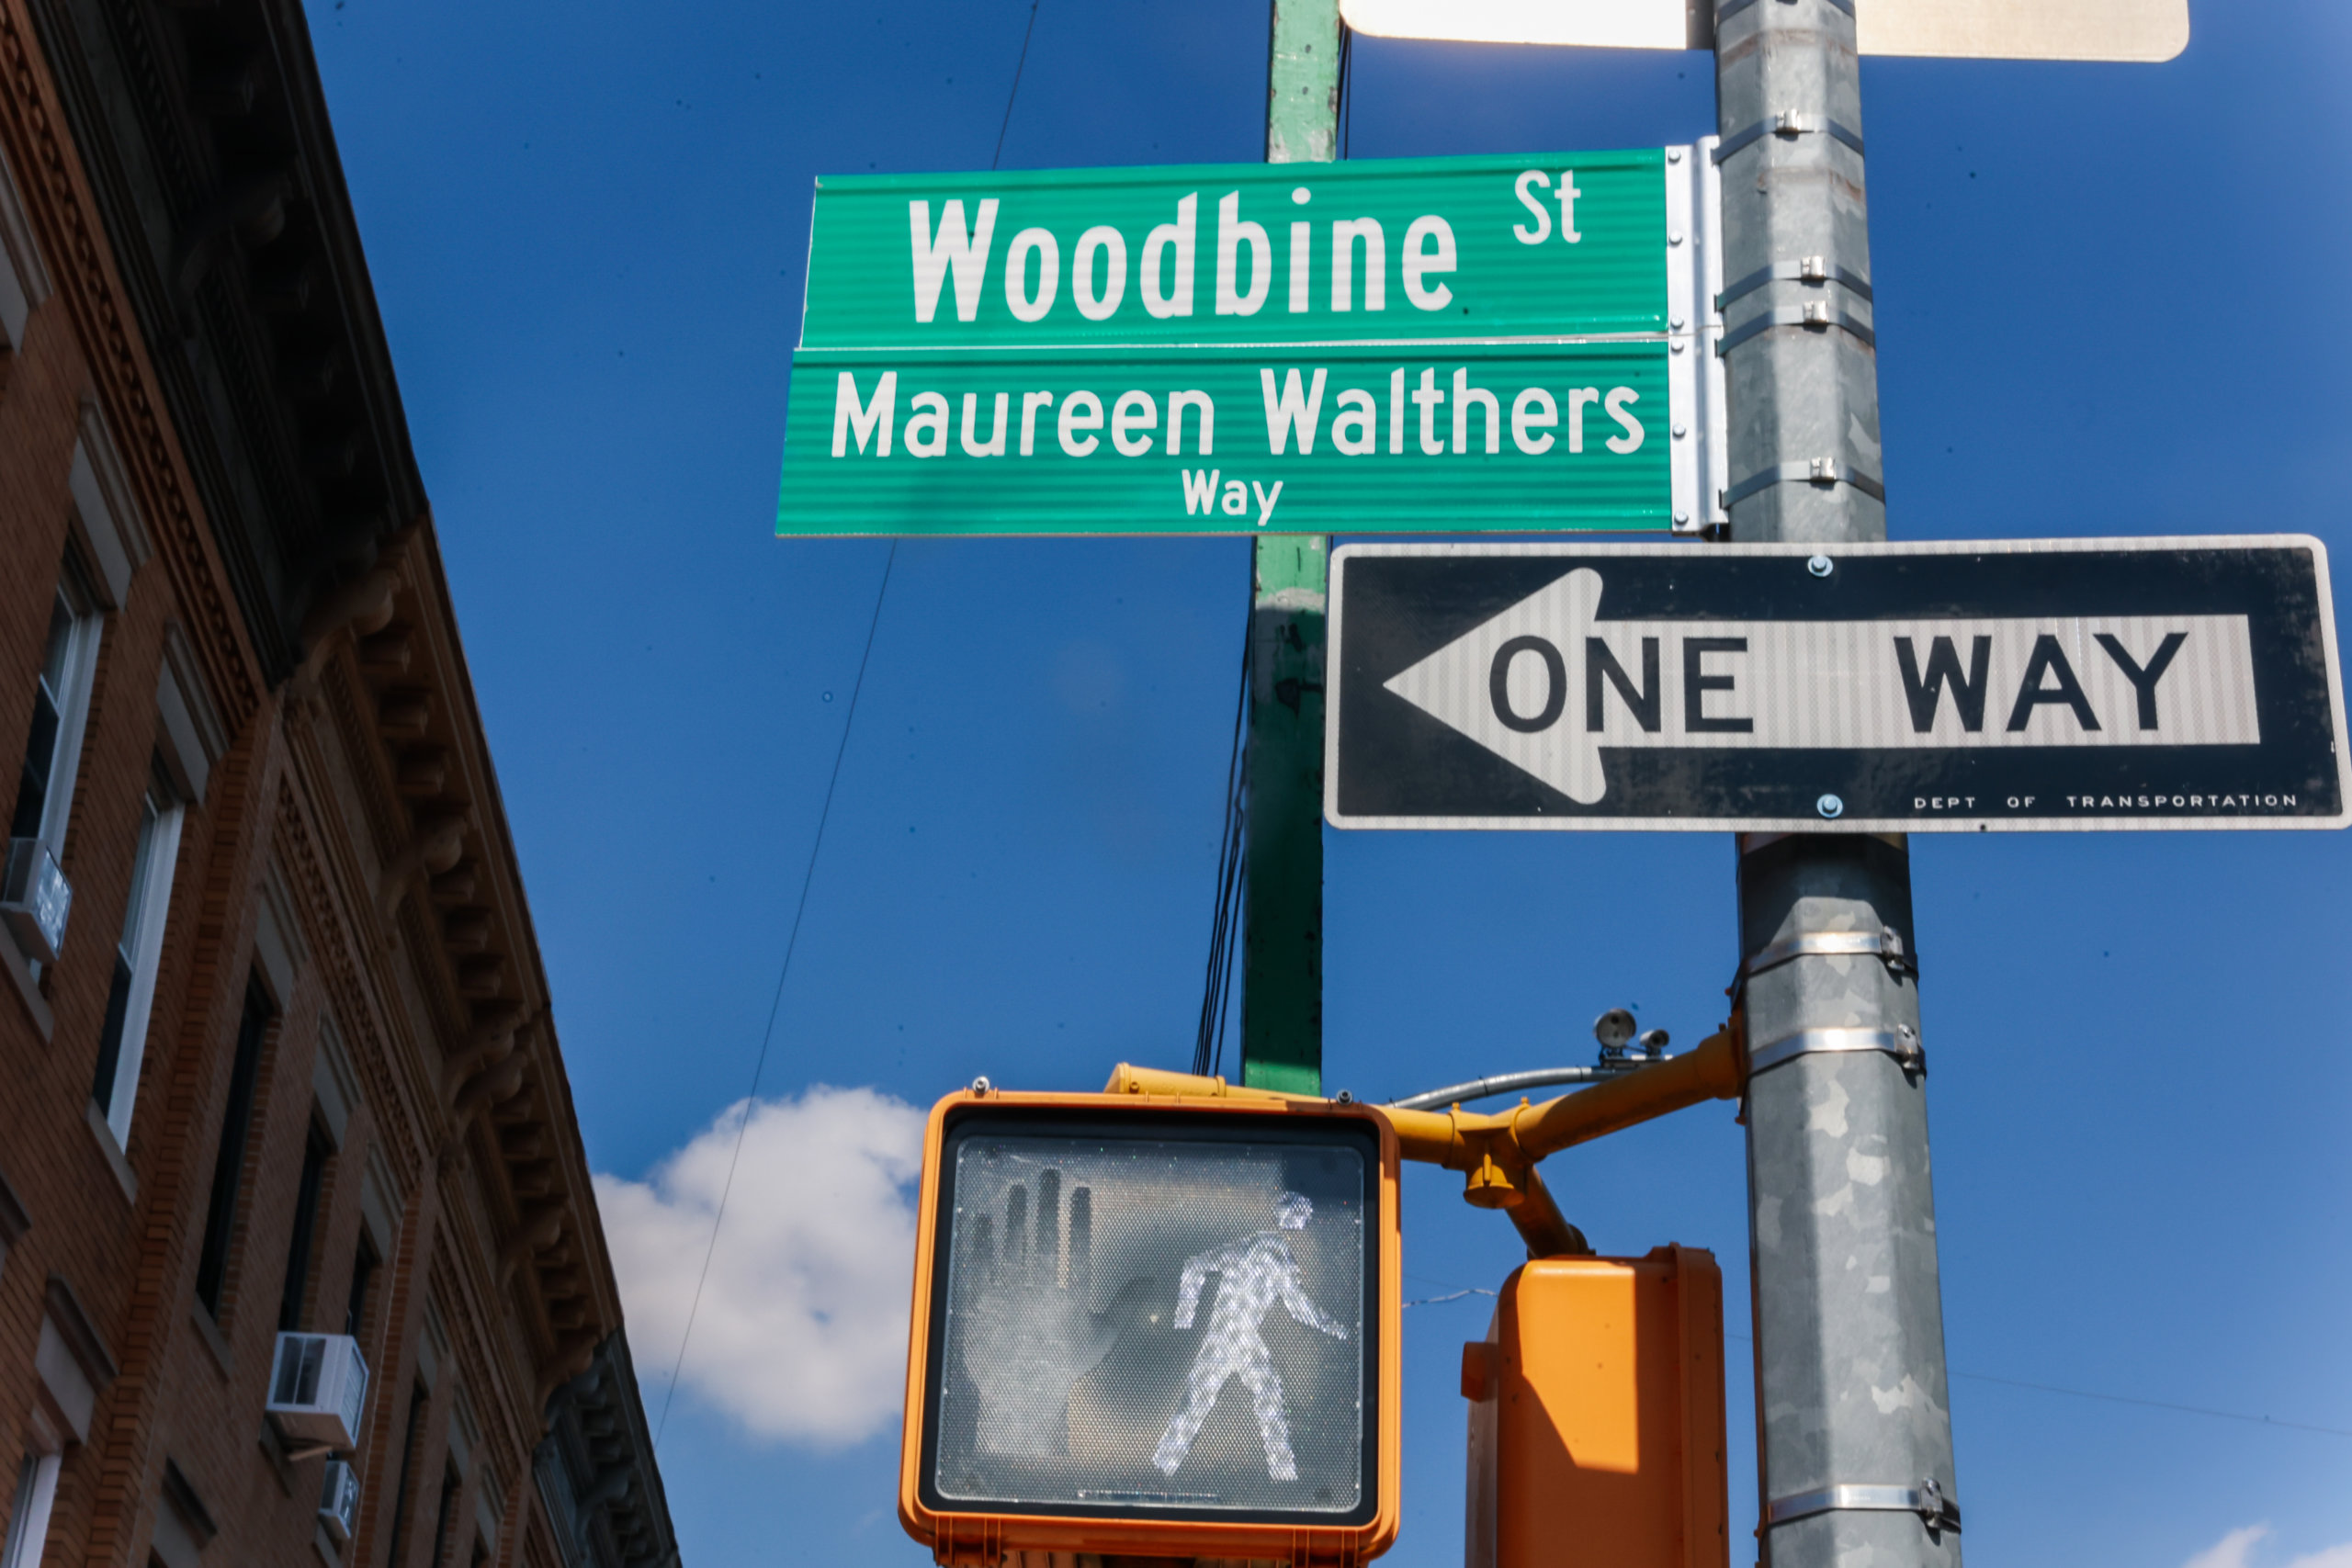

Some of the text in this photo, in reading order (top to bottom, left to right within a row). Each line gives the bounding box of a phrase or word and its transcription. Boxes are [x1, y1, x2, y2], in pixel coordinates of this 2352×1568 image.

[910, 170, 1582, 323] Woodbine St
[831, 367, 1645, 458] Maureen Walthers
[1182, 469, 1283, 526] Way
[1489, 631, 2188, 734] ONE WAY
[1914, 794, 2297, 809] DEPT OF TRANSPORTATION
